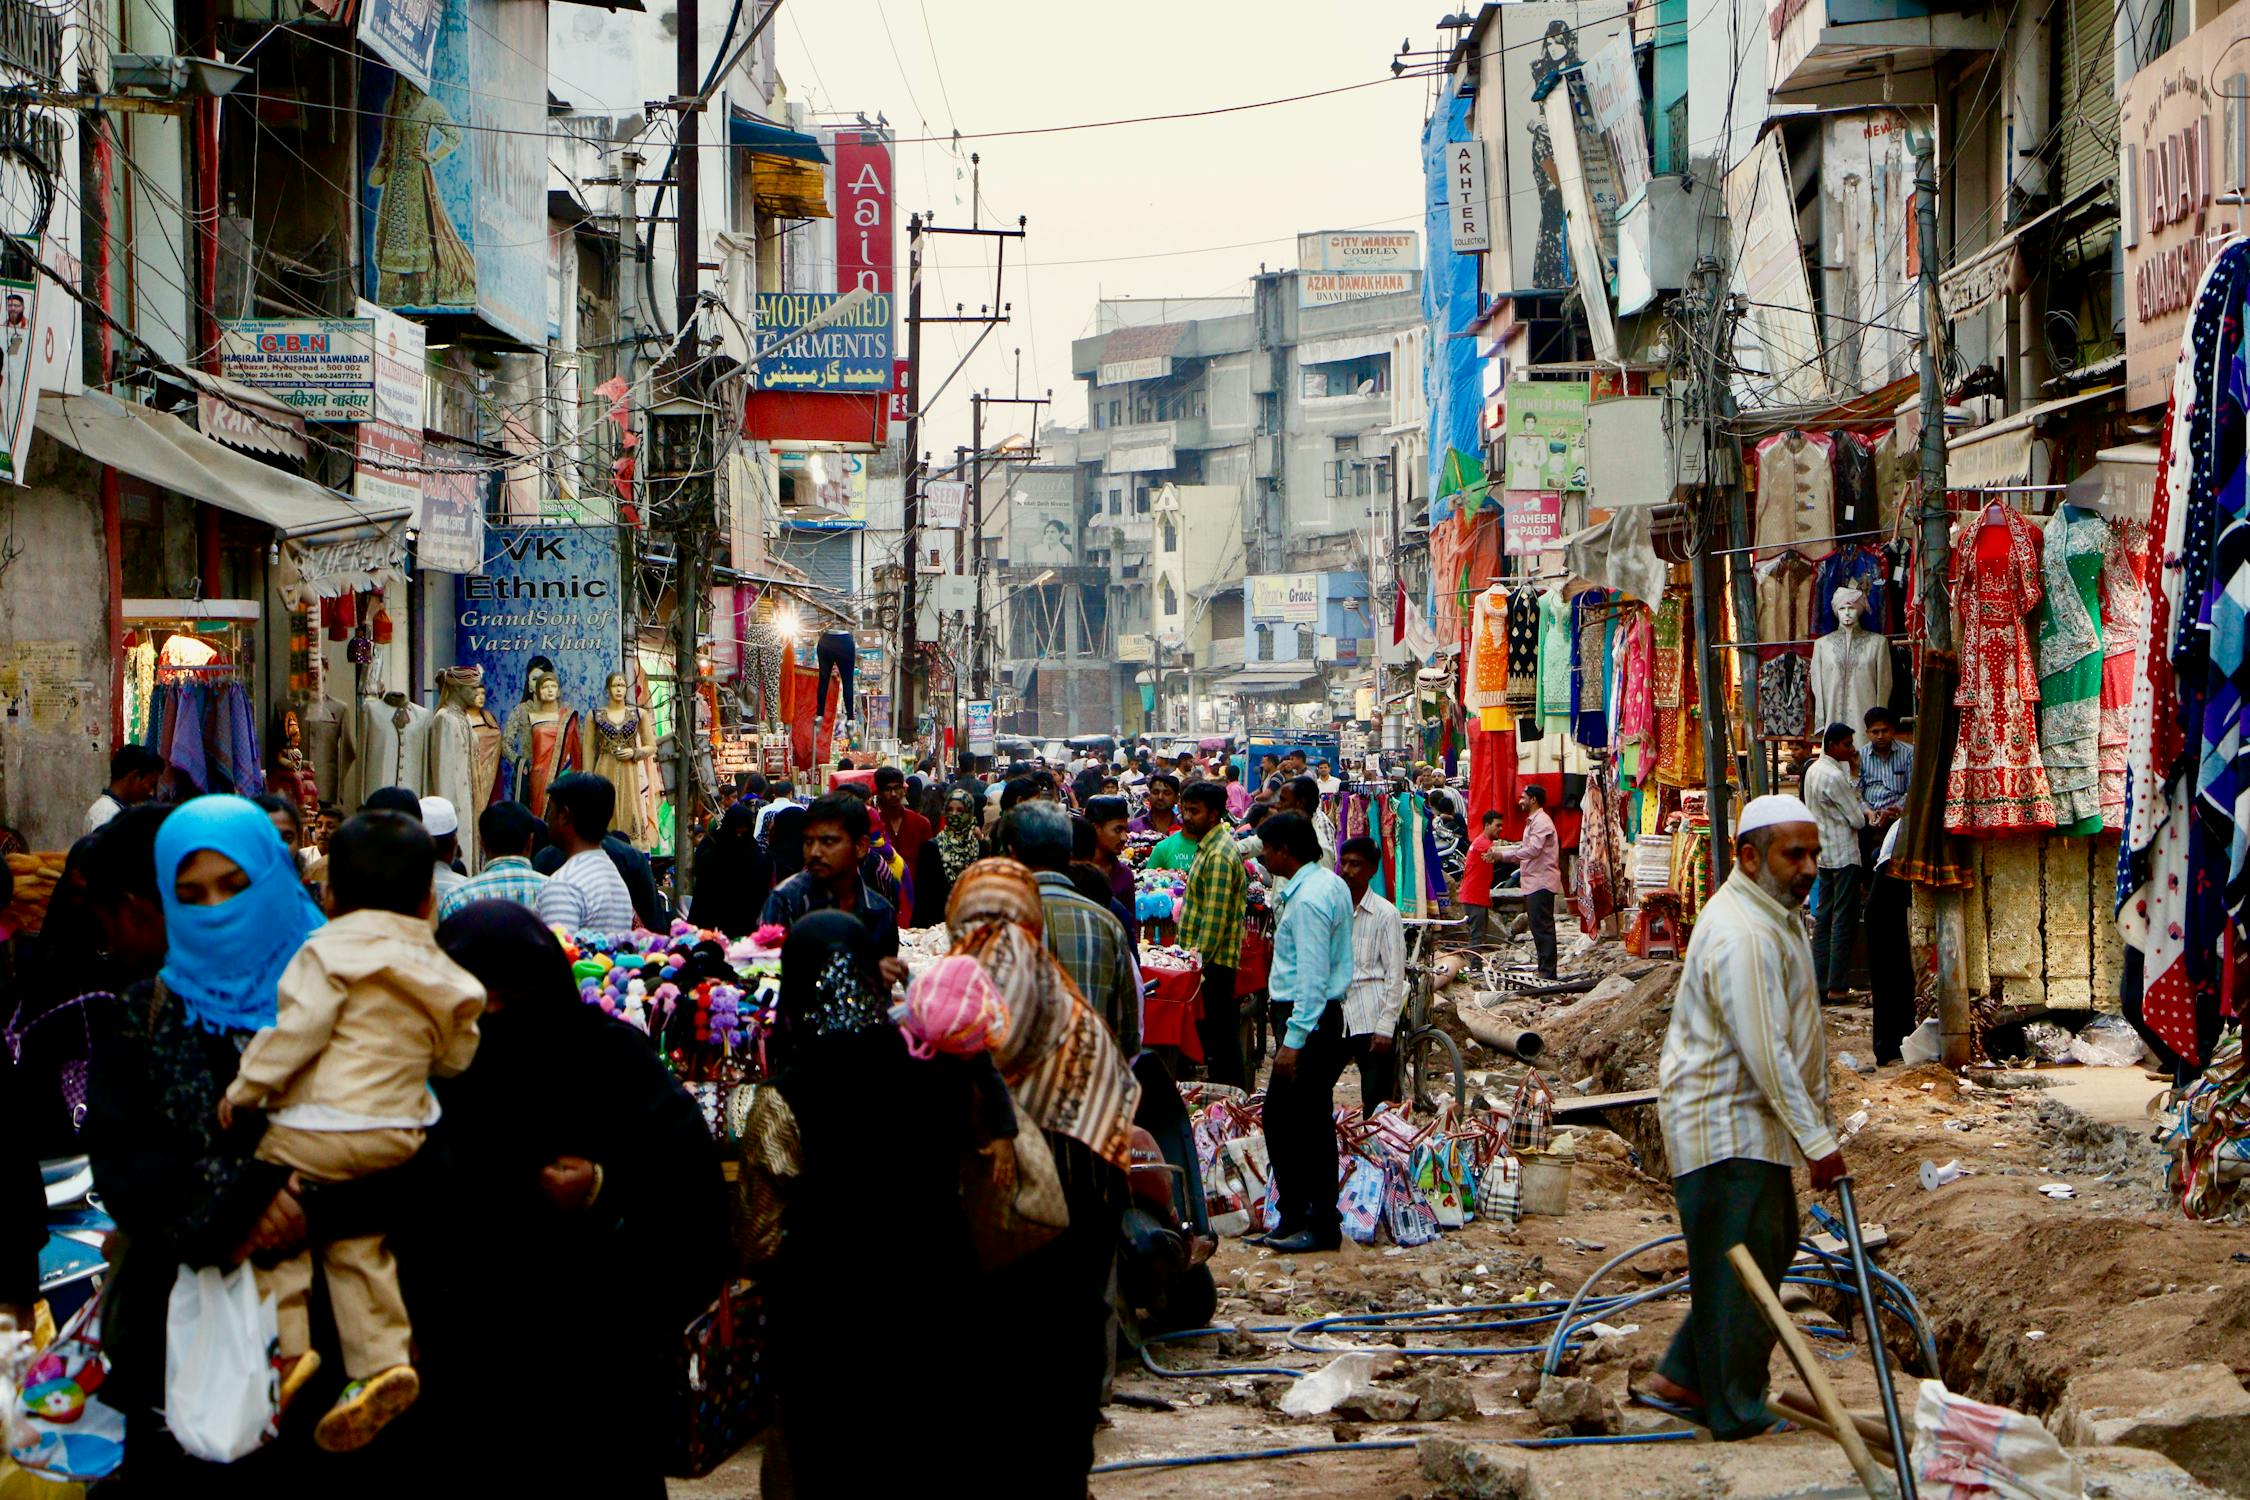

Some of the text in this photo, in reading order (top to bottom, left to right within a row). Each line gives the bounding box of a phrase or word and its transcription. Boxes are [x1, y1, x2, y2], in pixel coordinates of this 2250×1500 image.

[1863, 118, 1892, 139] NEW
[1458, 148, 1476, 233] AKHTER
[1331, 237, 1410, 247] CITY MARKET
[1454, 237, 1486, 247] COLLECTION
[1307, 275, 1404, 291] AZAM DAWAKHANA
[260, 335, 326, 352] G.B.N
[762, 333, 887, 359] GARMENTS
[267, 354, 318, 363] BALKISHAN
[320, 354, 370, 363] NAWANDAR
[843, 366, 886, 385] محمد
[1512, 514, 1556, 524] RAHEEM
[1520, 526, 1552, 536] PAGDI
[502, 536, 567, 560] VK
[465, 575, 607, 599] Ethnic
[1289, 588, 1313, 602] Grace
[460, 609, 613, 629] GrandSon of
[469, 634, 602, 651] Vazir Khan
